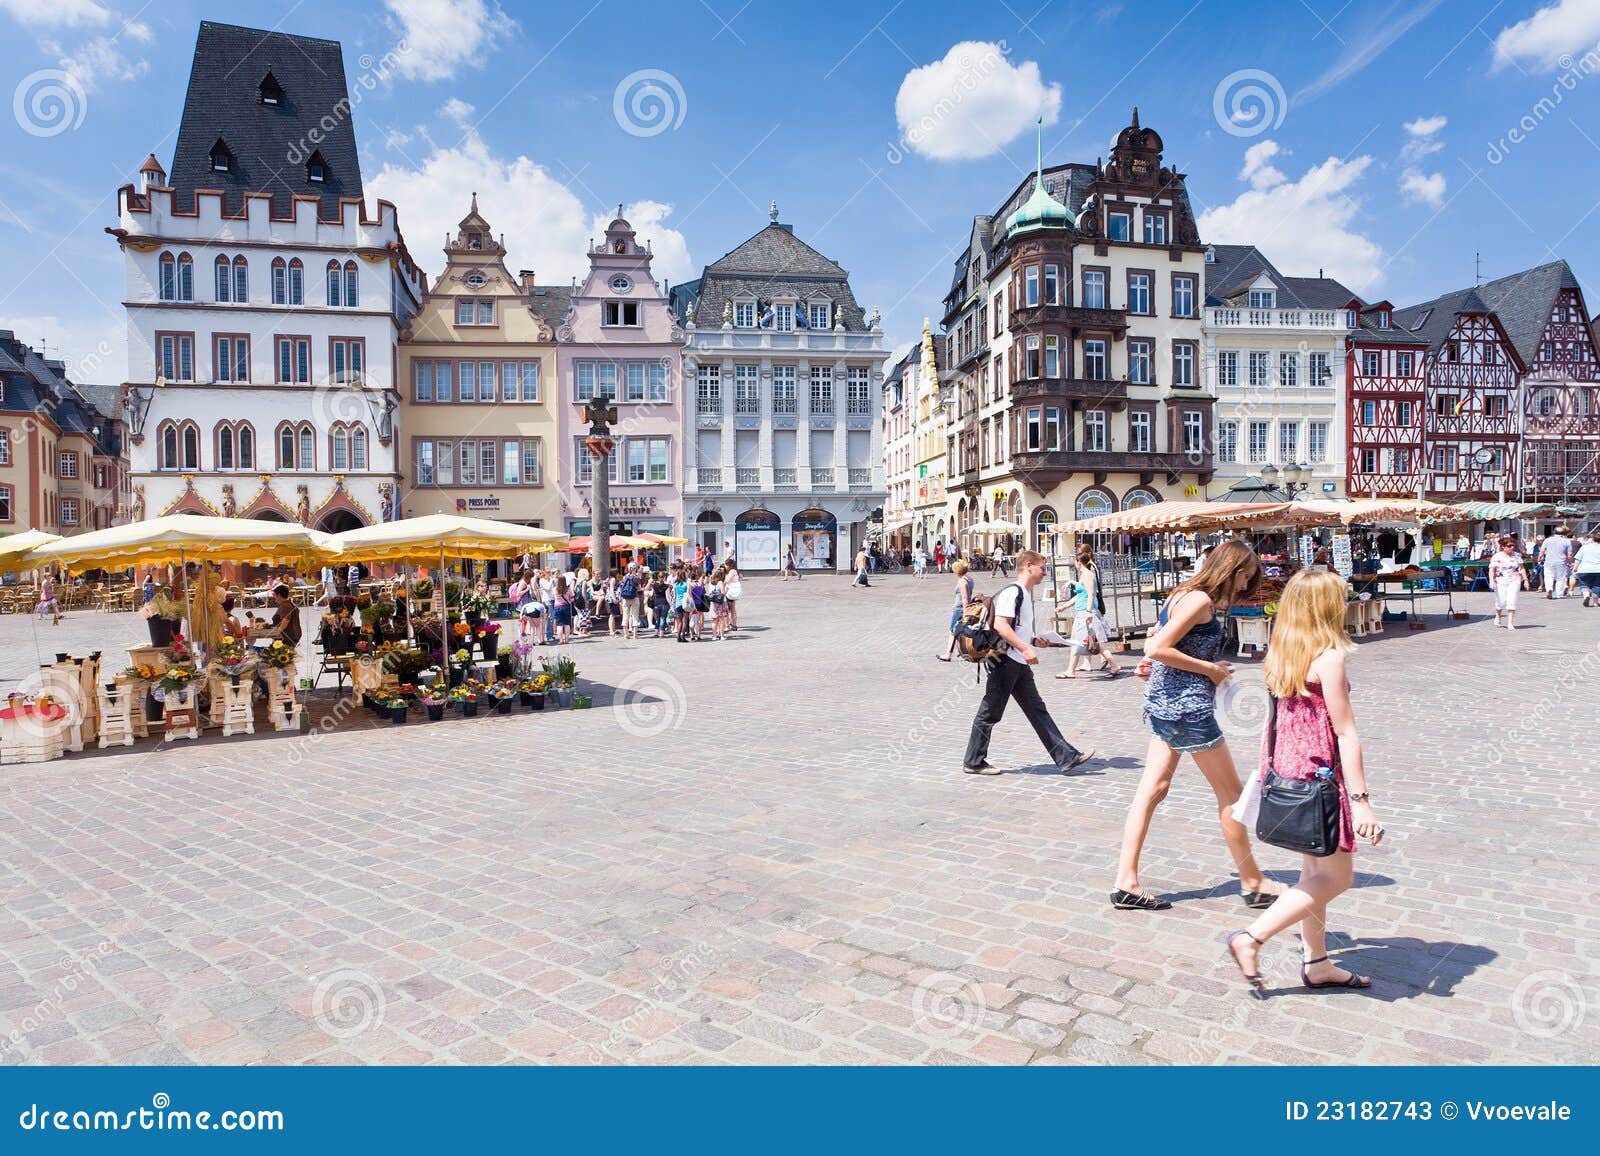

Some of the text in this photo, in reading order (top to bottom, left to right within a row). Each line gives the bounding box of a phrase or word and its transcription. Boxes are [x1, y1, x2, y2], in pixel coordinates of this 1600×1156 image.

[468, 498, 500, 506] PRESS POINT
[582, 497, 657, 507] ATHEKE
